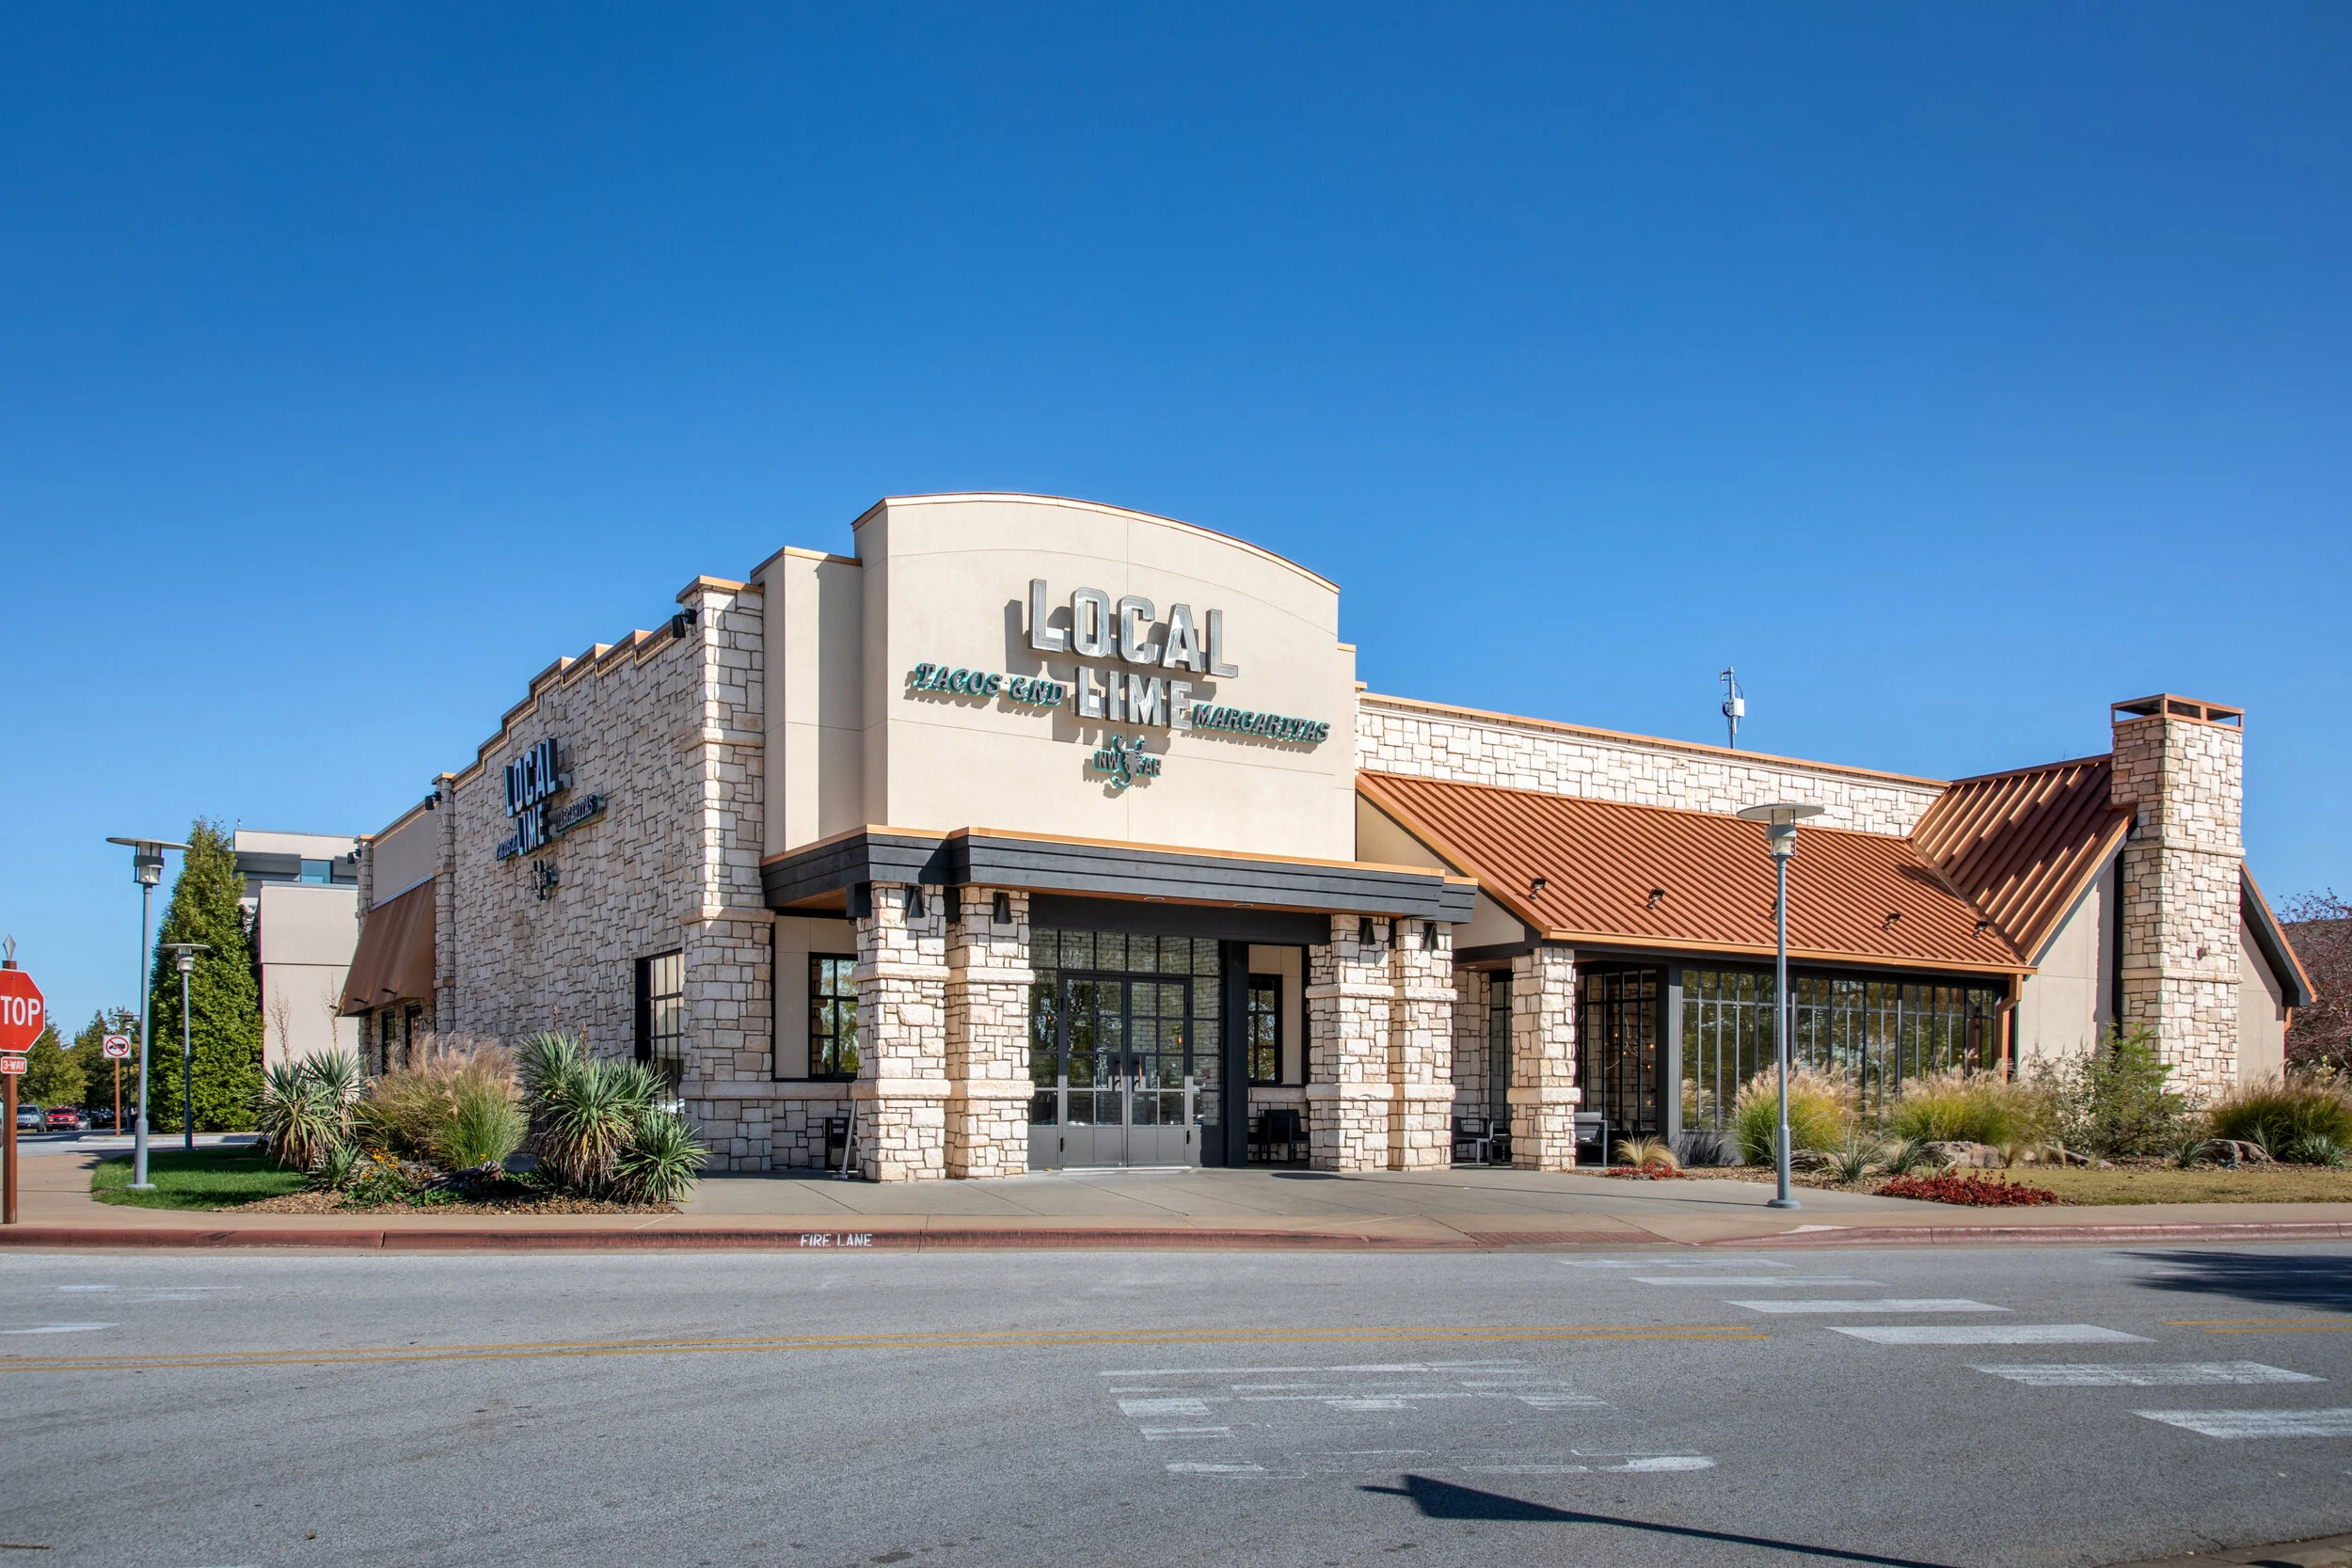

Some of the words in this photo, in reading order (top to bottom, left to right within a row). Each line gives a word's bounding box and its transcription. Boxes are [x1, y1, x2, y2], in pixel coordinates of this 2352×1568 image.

[1028, 578, 1238, 678] LOCAL
[915, 662, 1003, 697] TACOS
[1074, 666, 1193, 730] LIME
[1193, 703, 1330, 743] MARGARITAS
[504, 738, 560, 817] LOCAL
[1094, 750, 1120, 772] NW
[1142, 755, 1162, 778] AR
[516, 802, 548, 856] LIME
[0, 995, 41, 1026] TOP
[3, 1060, 25, 1071] 3-WAY
[800, 1233, 832, 1246] FIRE
[836, 1233, 872, 1246] LANE
